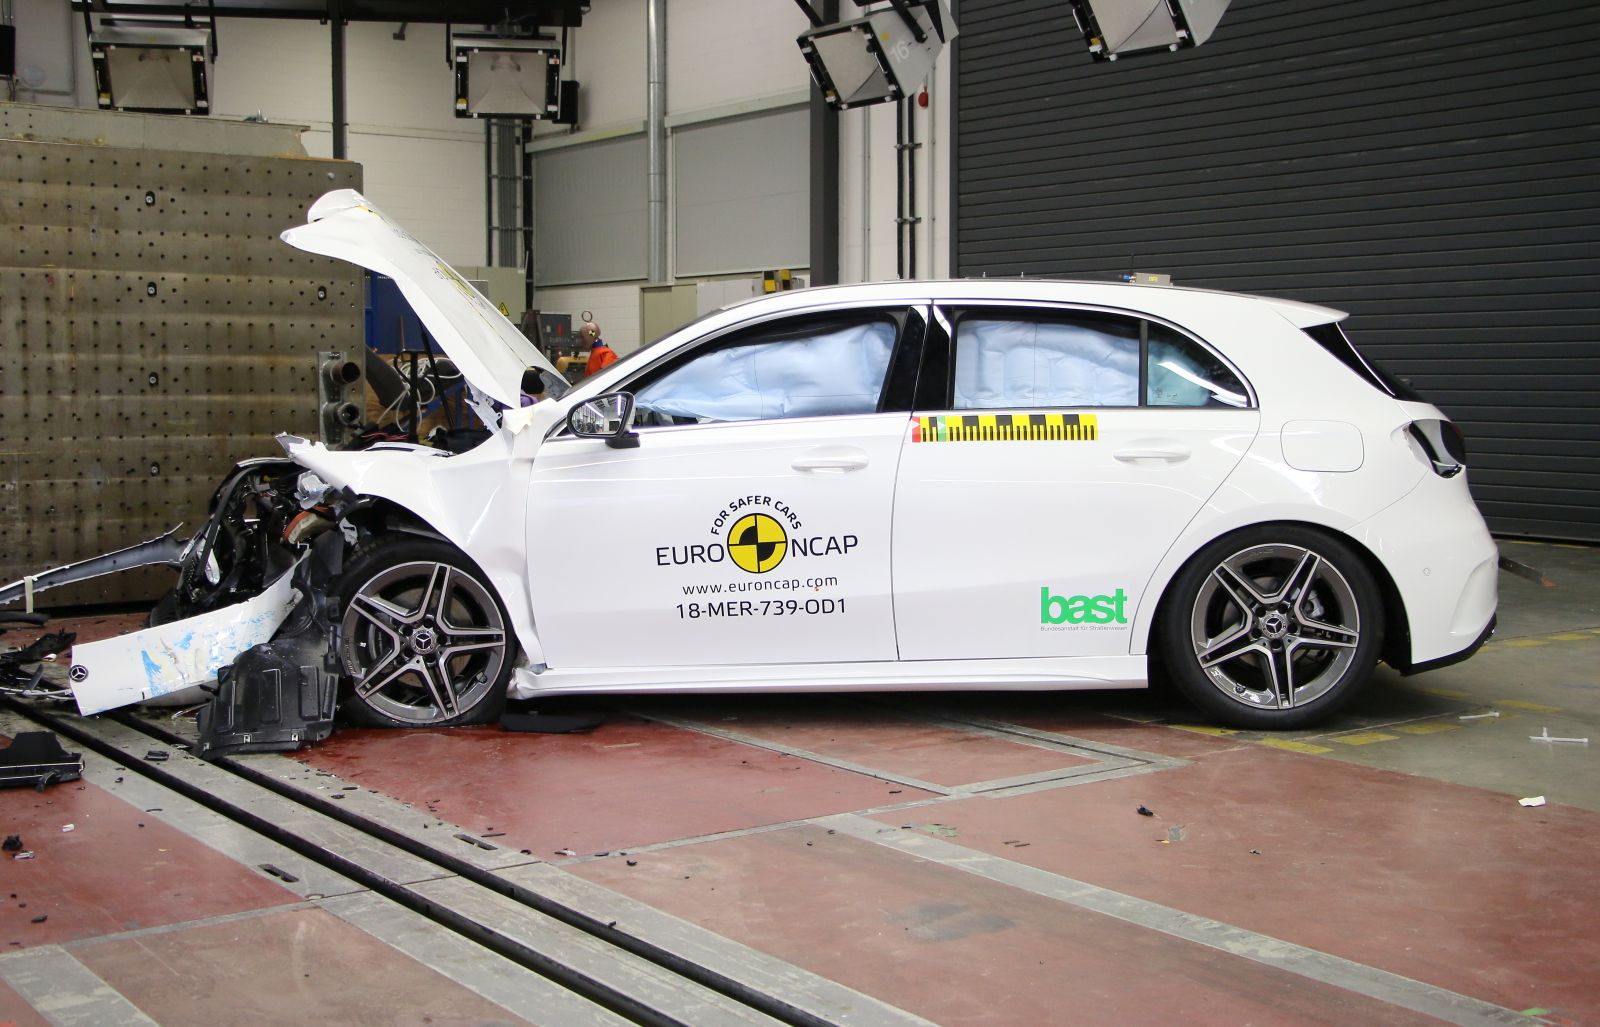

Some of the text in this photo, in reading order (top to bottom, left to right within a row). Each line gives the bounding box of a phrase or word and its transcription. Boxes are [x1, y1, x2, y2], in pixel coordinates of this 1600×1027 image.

[710, 495, 802, 535] FOR SAFER CARS
[656, 535, 858, 566] EURO NCAP
[682, 576, 838, 595] www.euroncap.com
[1041, 586, 1128, 624] bast
